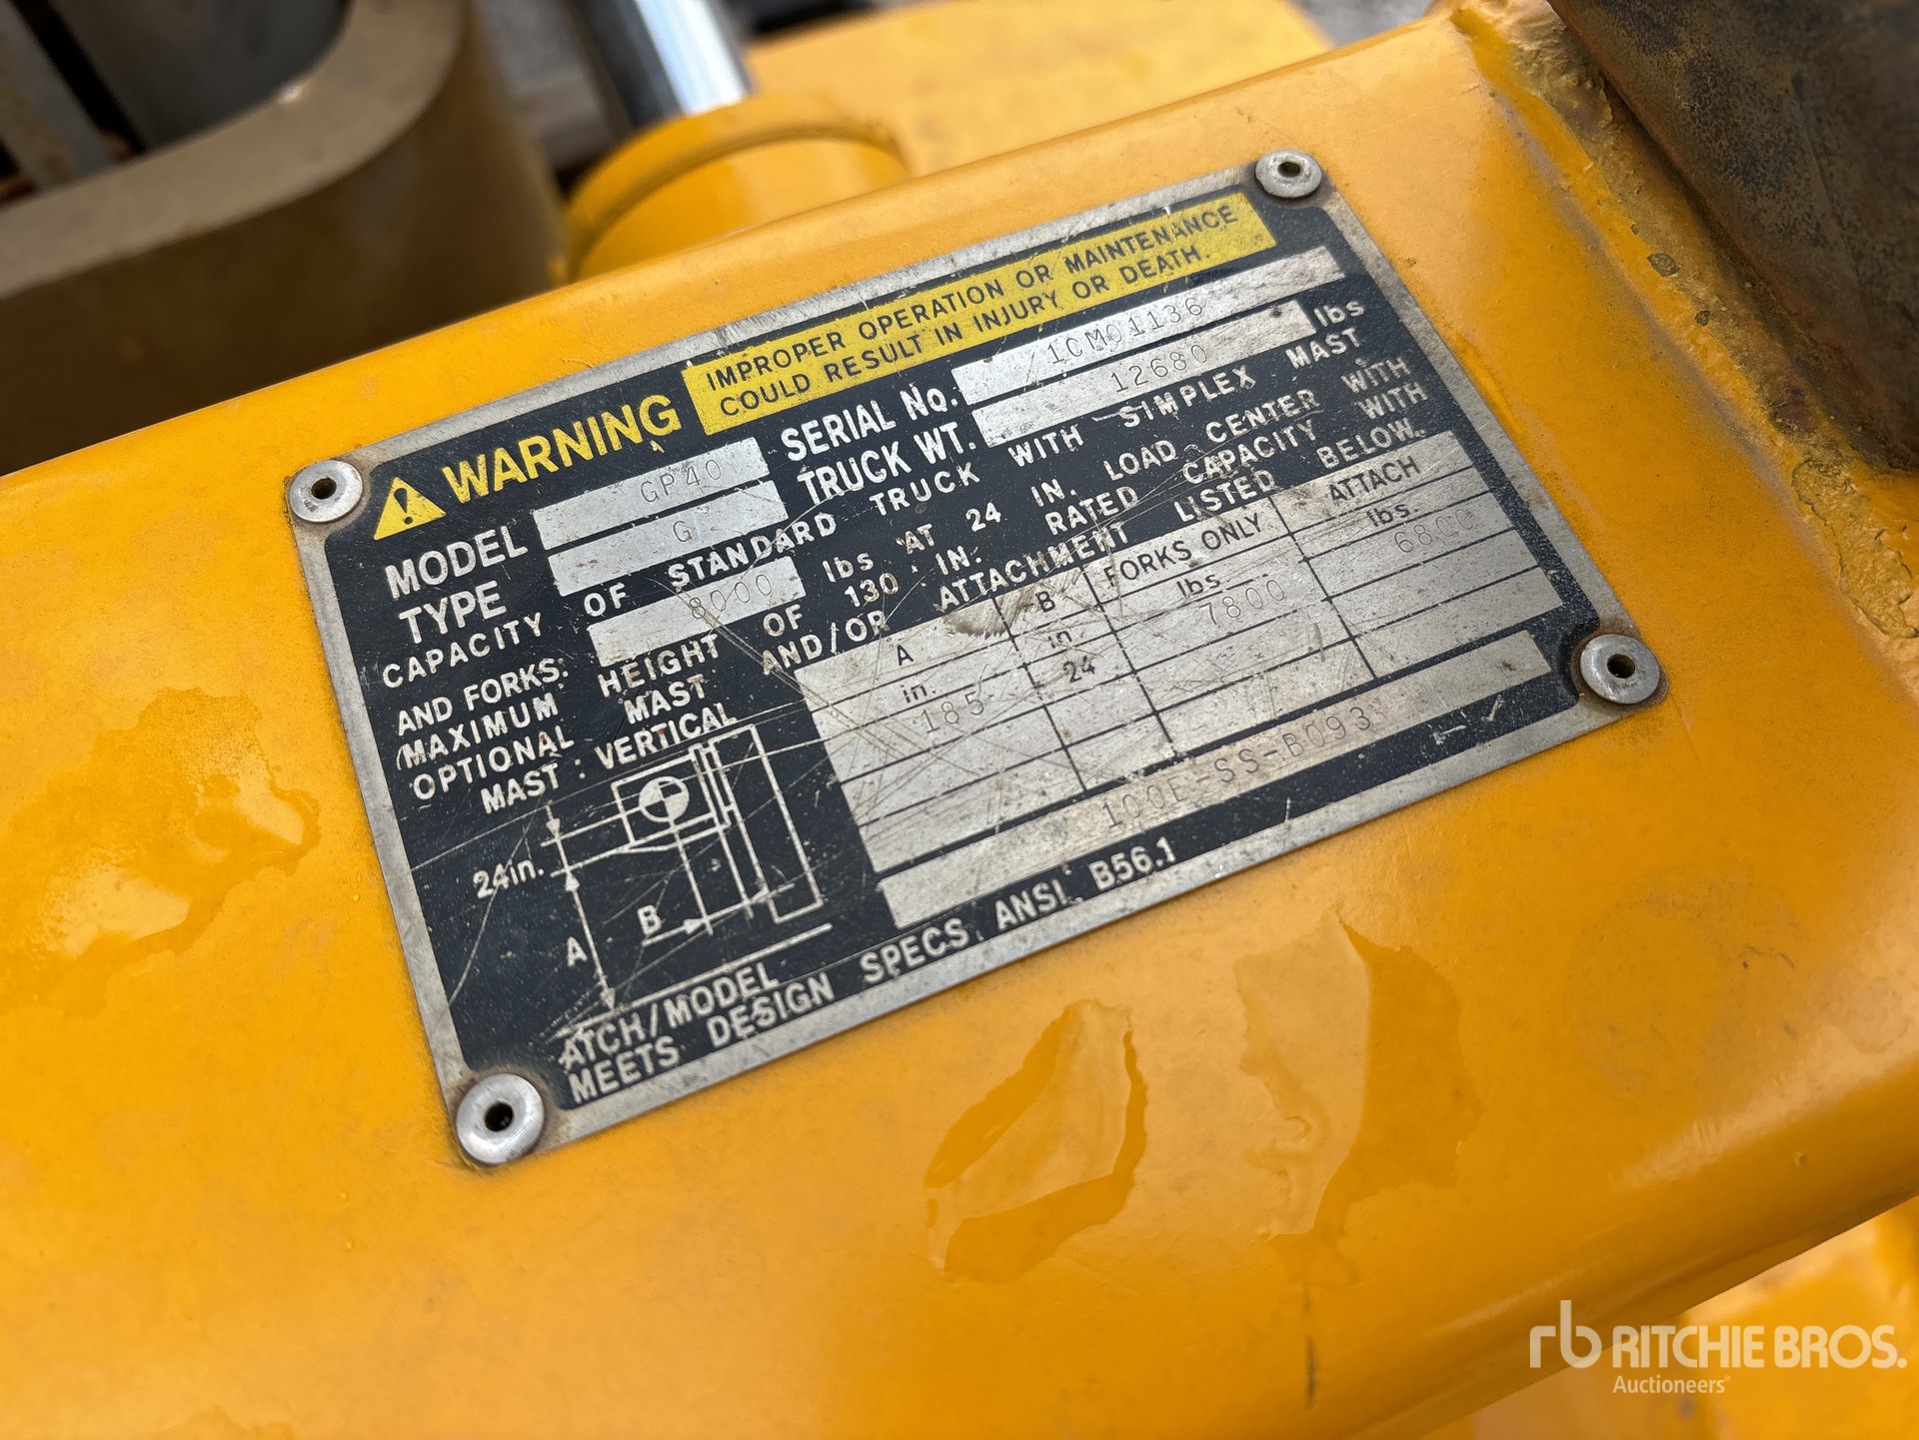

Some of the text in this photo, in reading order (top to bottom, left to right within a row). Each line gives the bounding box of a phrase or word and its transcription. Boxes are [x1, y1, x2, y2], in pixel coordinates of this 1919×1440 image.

[705, 203, 1238, 392] IMPROPER OPERATION OR MAINTENANCE
[719, 243, 1210, 416] COULD RESULT IN INJURY OR DEATH.
[779, 399, 897, 462] SERIAL
[795, 294, 1368, 505] TRUCK WT. 12680 lbs
[440, 393, 682, 504] WARNING
[1328, 454, 1421, 501] ATTACH
[381, 326, 1360, 688] CAPACITY OF STANDARD TRUCK WITH SIMPLEX MAST
[383, 456, 725, 599] MODEL GP40
[1364, 502, 1419, 528] lbs.
[397, 355, 1411, 737] AND FORKS: 8000 lbs AT 24 IN. LOAD CENTER WITH
[397, 518, 693, 644] TYPE G
[399, 691, 559, 769] MAXIMUM
[596, 632, 719, 698] HEIGHT
[762, 602, 803, 637] OF
[843, 571, 899, 608] 130
[1043, 485, 1141, 536] RATED
[1178, 418, 1316, 485] CAPACITY
[1357, 381, 1428, 420] WITH
[1102, 511, 1262, 588] FORKS ONLY
[412, 416, 1426, 800] OPTIONAL MAST AND/OR ATTACHMENT LISTED BELOW.
[1033, 589, 1056, 613] B
[1197, 577, 1288, 627] 7800
[895, 643, 915, 666] A
[899, 675, 936, 703] in.
[1061, 654, 1096, 684] 24
[593, 701, 739, 769] VERTICAL
[918, 690, 987, 733] 185
[558, 932, 590, 969] A
[634, 900, 665, 938] B
[567, 1034, 680, 1103] MEETS
[705, 971, 834, 1047] DESIGN
[1087, 835, 1176, 890] B56.1
[559, 961, 780, 1070] ATCH/MODEL
